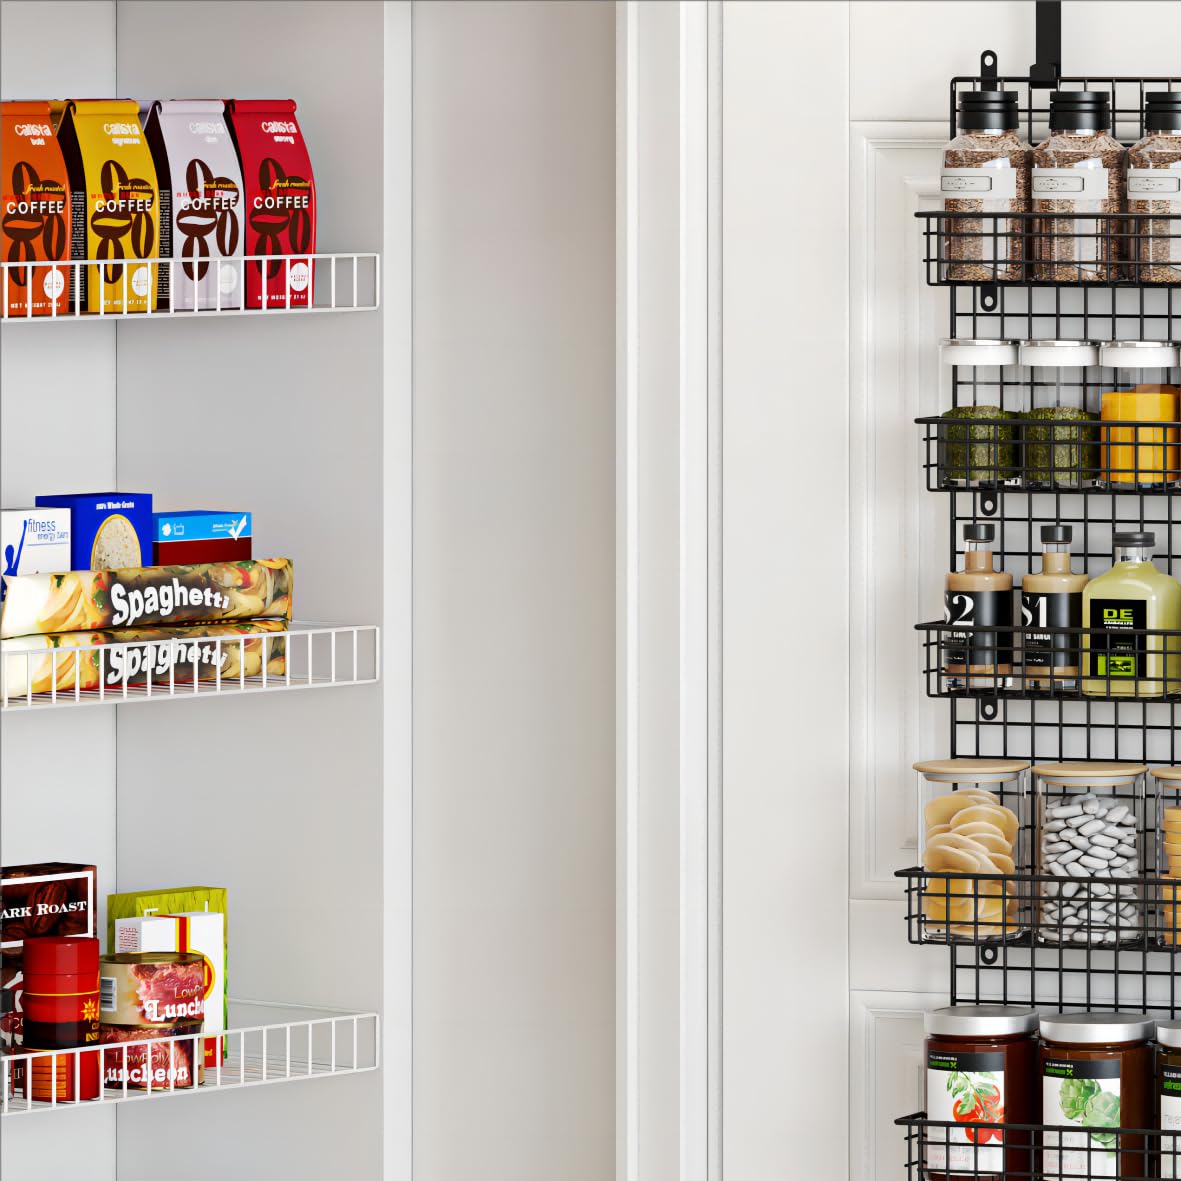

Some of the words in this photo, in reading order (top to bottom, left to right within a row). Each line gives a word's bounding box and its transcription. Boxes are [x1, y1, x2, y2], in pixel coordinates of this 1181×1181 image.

[6, 200, 64, 214] COFFEE
[95, 199, 152, 213] COFFEE
[180, 197, 239, 211] COFFEE
[253, 195, 309, 209] COFFEE
[28, 519, 56, 532] fitness
[111, 577, 229, 626] Spaghetti
[1103, 608, 1134, 619] DE
[36, 901, 87, 916] ROAST
[104, 1063, 188, 1084] uncheon
